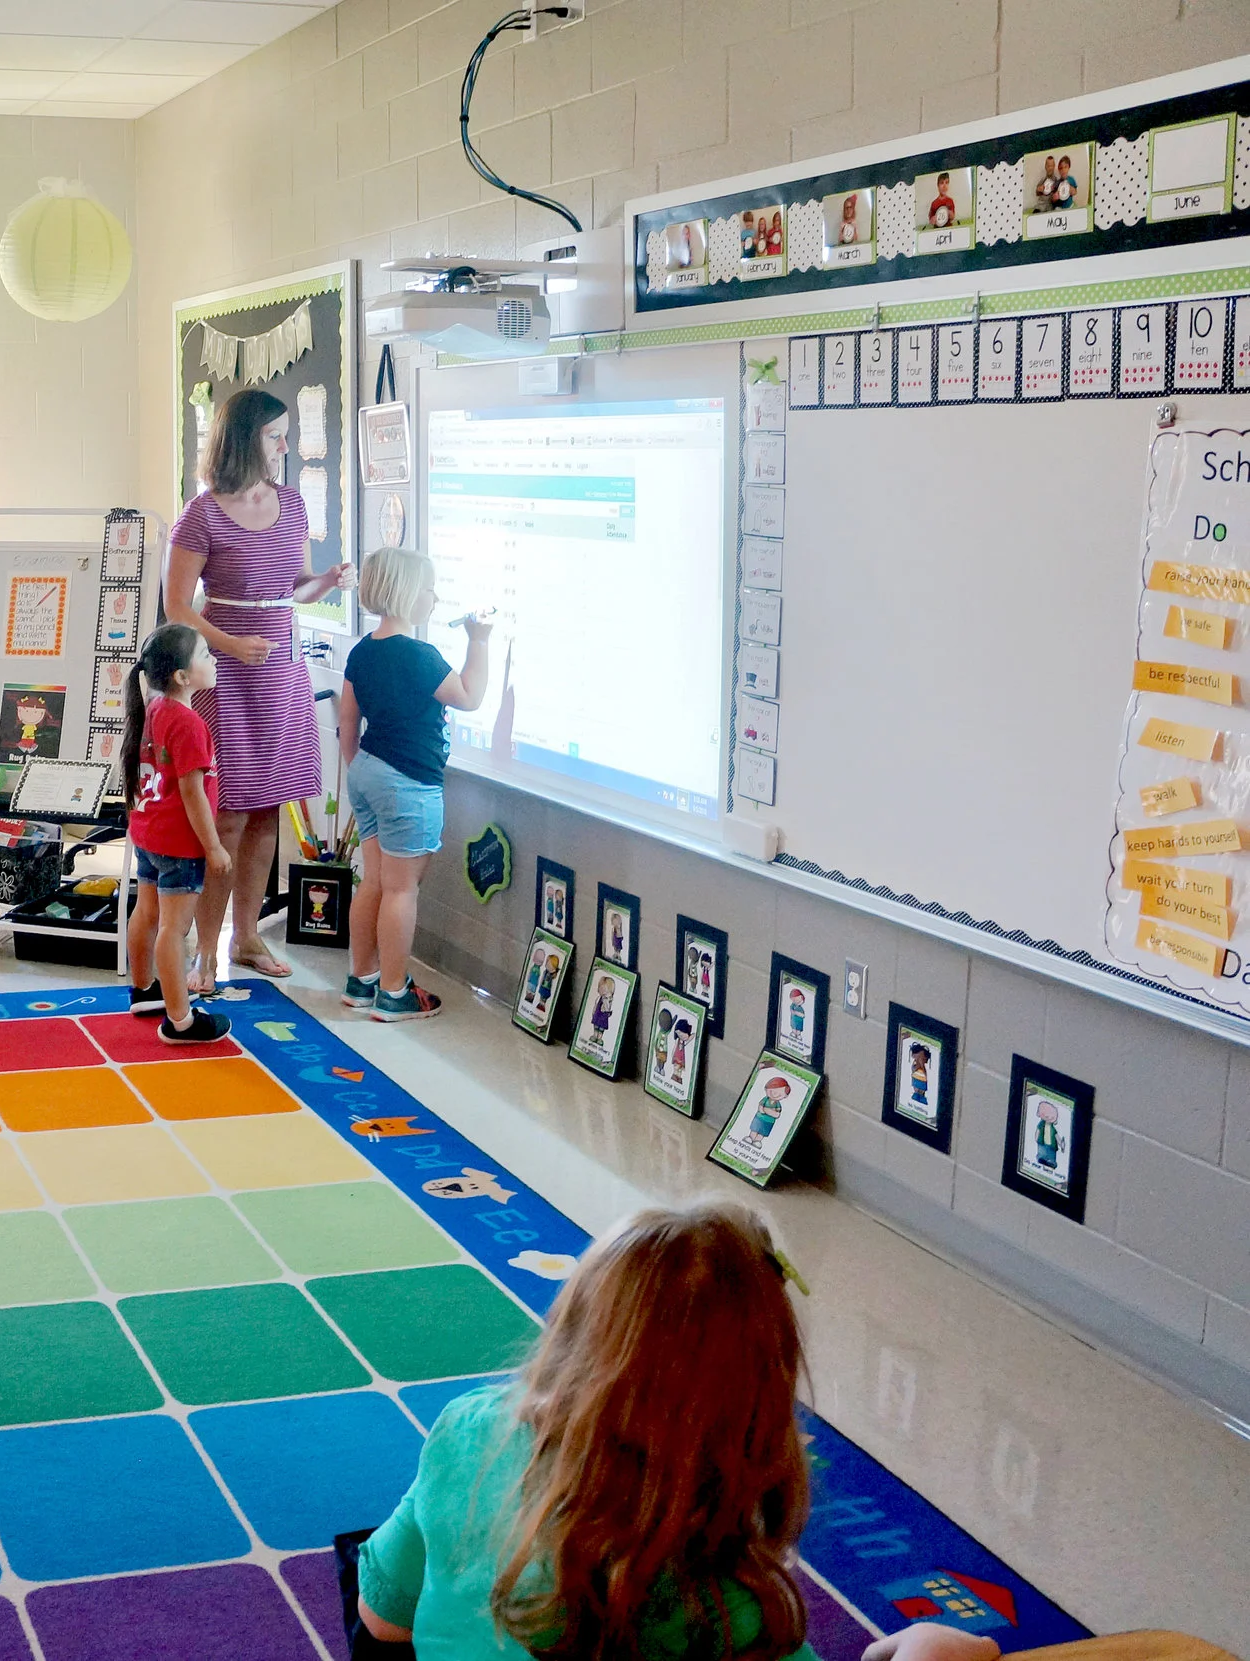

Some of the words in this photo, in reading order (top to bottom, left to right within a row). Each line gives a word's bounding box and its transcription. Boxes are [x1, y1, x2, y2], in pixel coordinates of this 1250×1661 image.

[1085, 318, 1098, 346] 8
[1136, 313, 1151, 343] 9
[1189, 306, 1213, 339] 10
[909, 335, 920, 361] 4
[950, 331, 962, 357] 5
[992, 327, 1003, 354] 6
[1036, 324, 1049, 352] 7
[835, 341, 844, 365] 2
[871, 338, 882, 362] 3
[1132, 350, 1152, 361] nine
[1191, 341, 1209, 356] ten
[948, 359, 963, 372] five
[991, 360, 1002, 370] six
[1029, 358, 1054, 368] seven
[1078, 350, 1103, 369] eight
[798, 373, 810, 381] one
[832, 367, 846, 379] two
[866, 365, 885, 377] three
[906, 364, 922, 376] four
[1194, 515, 1227, 541] Do
[1149, 667, 1164, 680] be
[1155, 731, 1185, 747] listen
[1153, 786, 1178, 802] walk
[1127, 840, 1155, 852] keep
[1192, 836, 1202, 845] to
[1203, 829, 1237, 846] yourself
[1137, 874, 1161, 886] wait
[1193, 881, 1214, 895] turn
[1156, 895, 1170, 907] do
[1173, 902, 1197, 915] your
[1200, 906, 1221, 925] best
